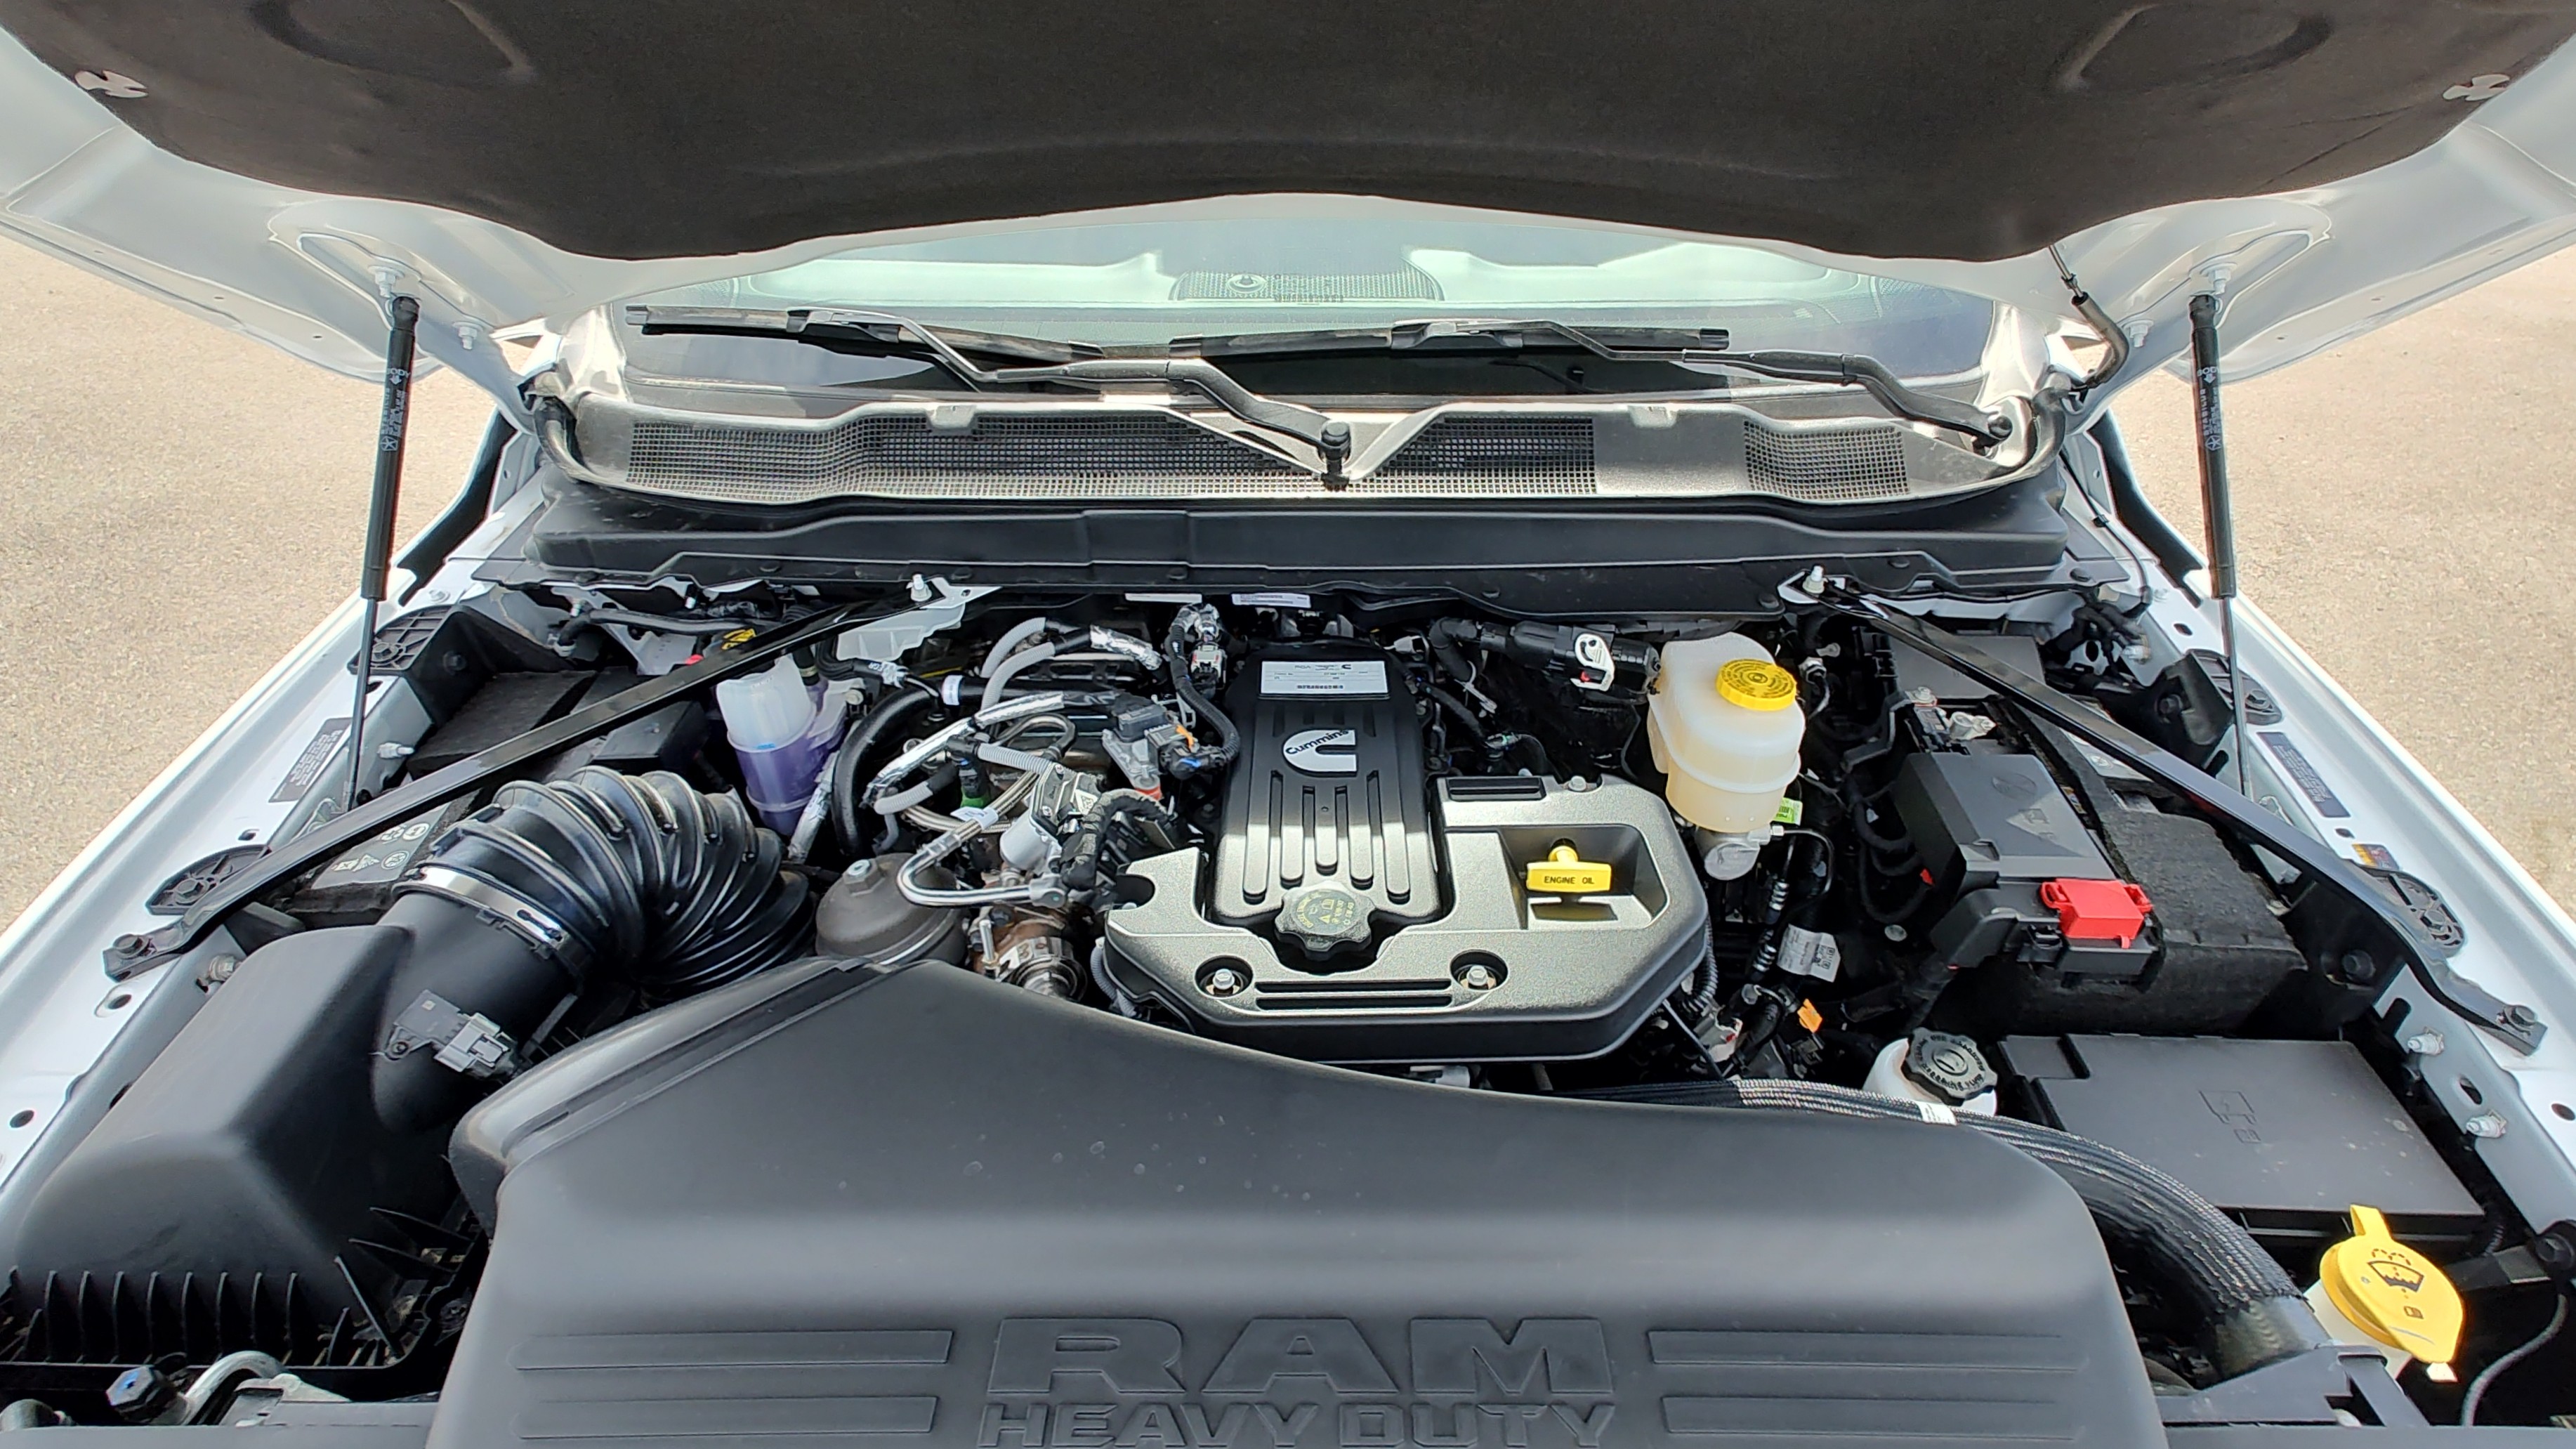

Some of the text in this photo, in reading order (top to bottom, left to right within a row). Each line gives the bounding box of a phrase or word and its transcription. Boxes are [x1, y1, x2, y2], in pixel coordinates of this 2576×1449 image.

[1284, 729, 1349, 755] Cummins
[1544, 875, 1576, 884] ENGINE
[987, 1317, 1614, 1394] RAM
[977, 1403, 1615, 1448] HEAVY DUTY
